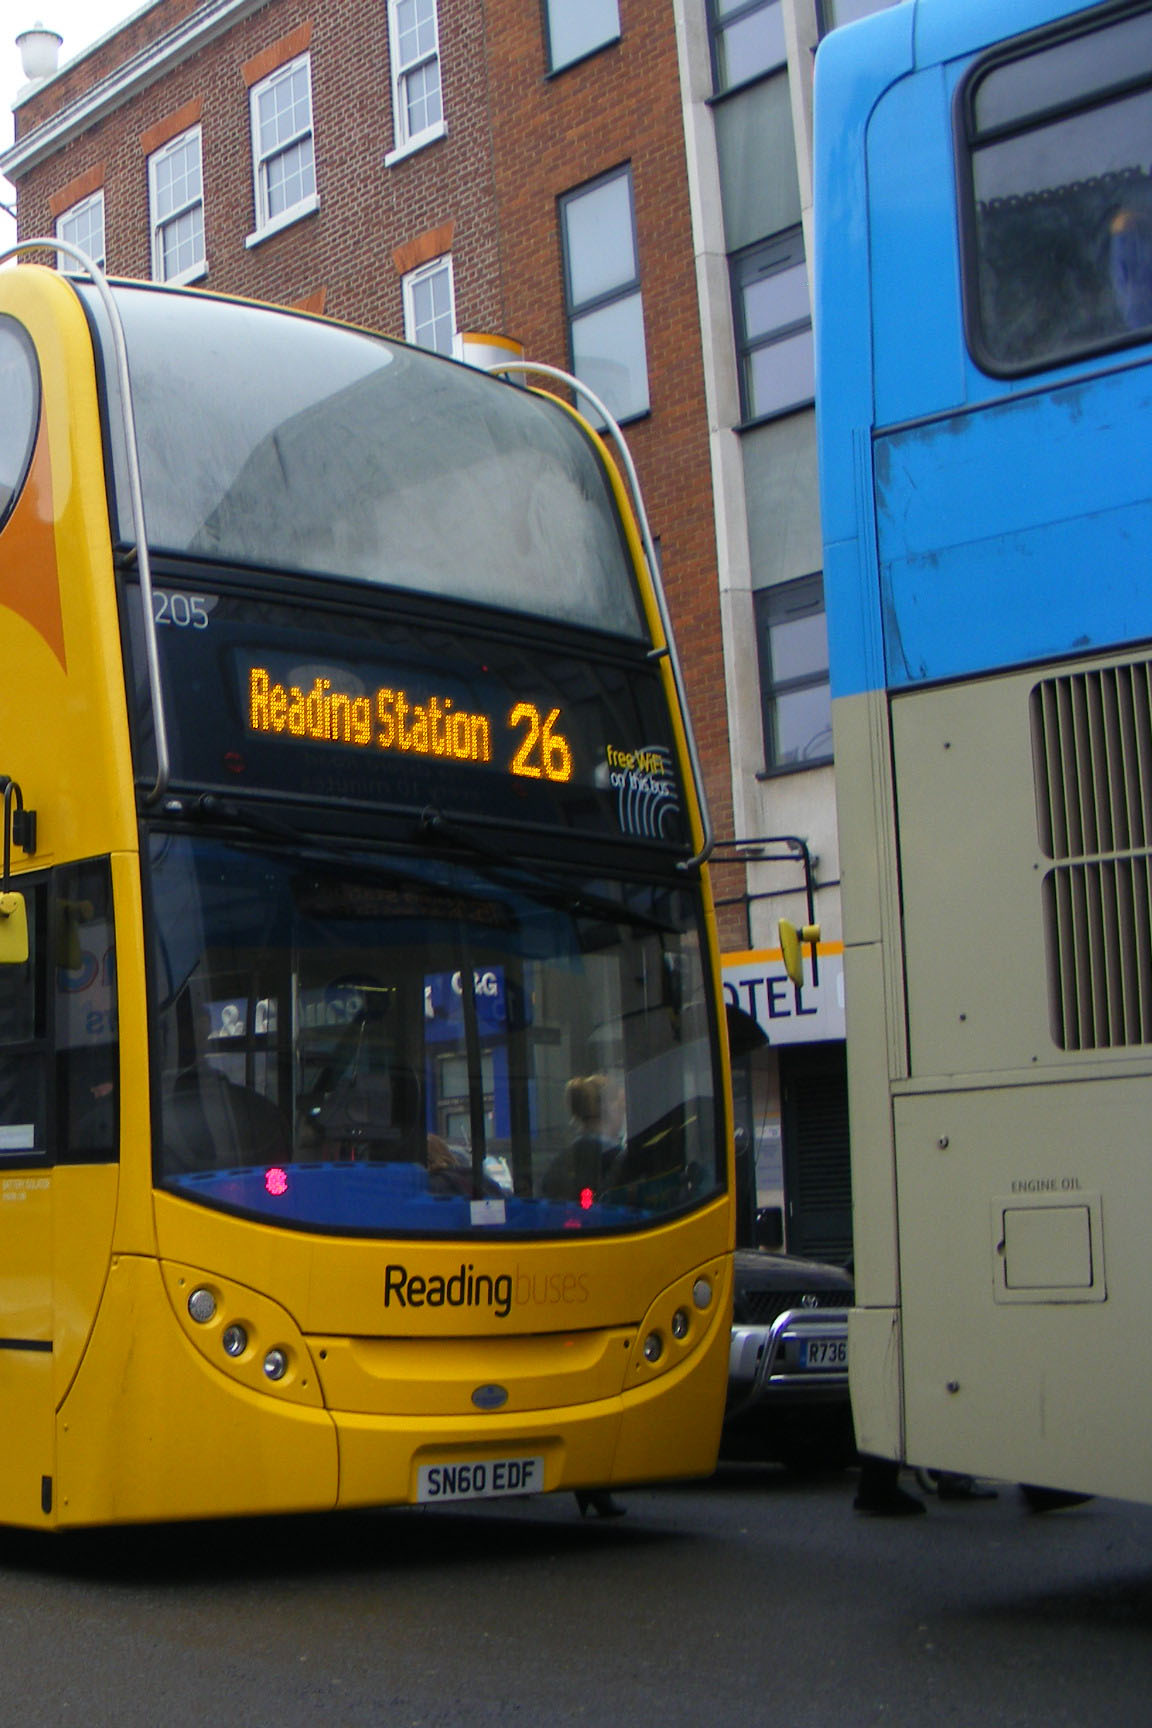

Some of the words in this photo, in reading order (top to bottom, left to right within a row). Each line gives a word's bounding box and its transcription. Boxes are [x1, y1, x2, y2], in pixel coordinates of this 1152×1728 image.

[153, 590, 210, 630] 205
[250, 667, 372, 745] Reading
[376, 688, 491, 763] Station
[508, 702, 575, 784] 26
[607, 744, 635, 770] free
[1011, 1178, 1056, 1193] ENGINE
[1061, 1177, 1082, 1191] OIL
[384, 1264, 513, 1319] Reading
[809, 1342, 847, 1364] R736
[427, 1464, 487, 1496] SN60
[492, 1460, 535, 1490] EDF
